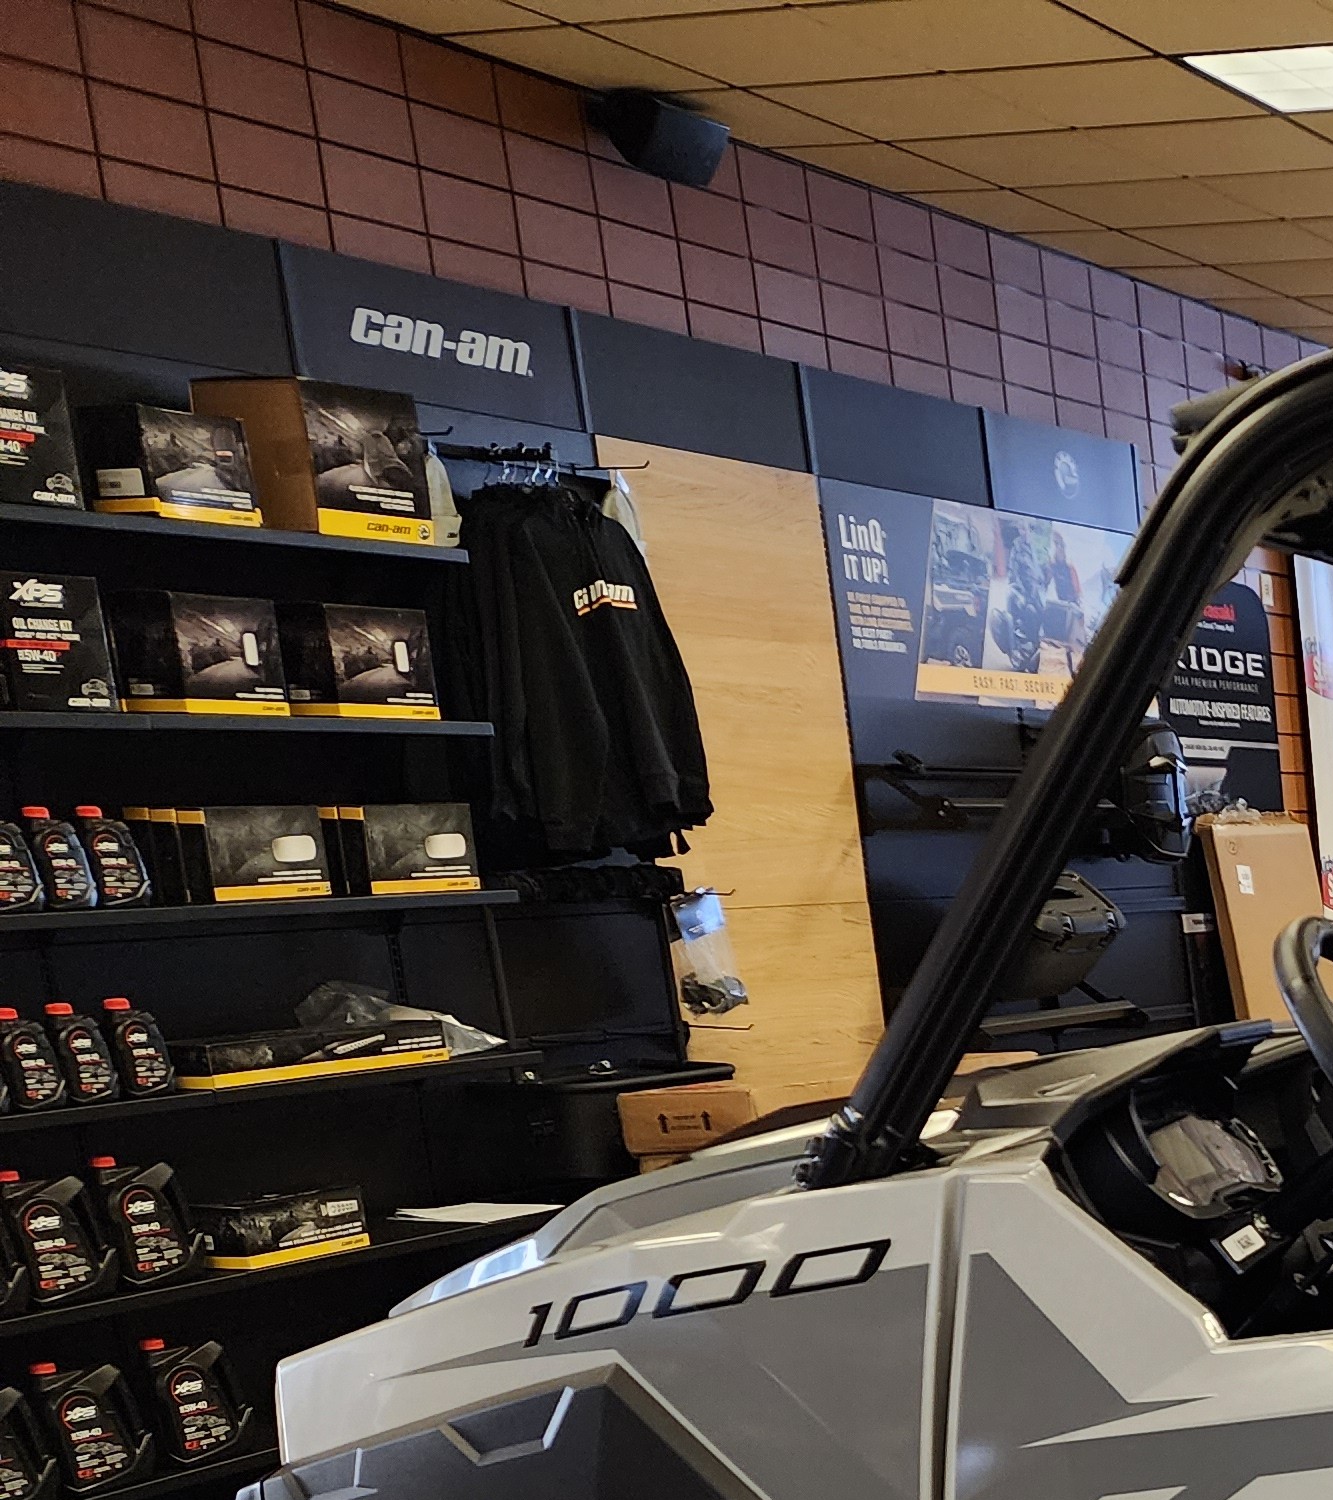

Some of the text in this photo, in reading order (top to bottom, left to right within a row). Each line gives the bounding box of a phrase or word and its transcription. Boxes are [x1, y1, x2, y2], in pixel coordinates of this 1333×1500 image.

[350, 306, 534, 378] can-am
[367, 522, 411, 535] can-am
[843, 554, 890, 586] IT UP!
[9, 578, 64, 602] XPS
[1177, 645, 1265, 679] IDGE
[523, 1238, 892, 1349] 1000
